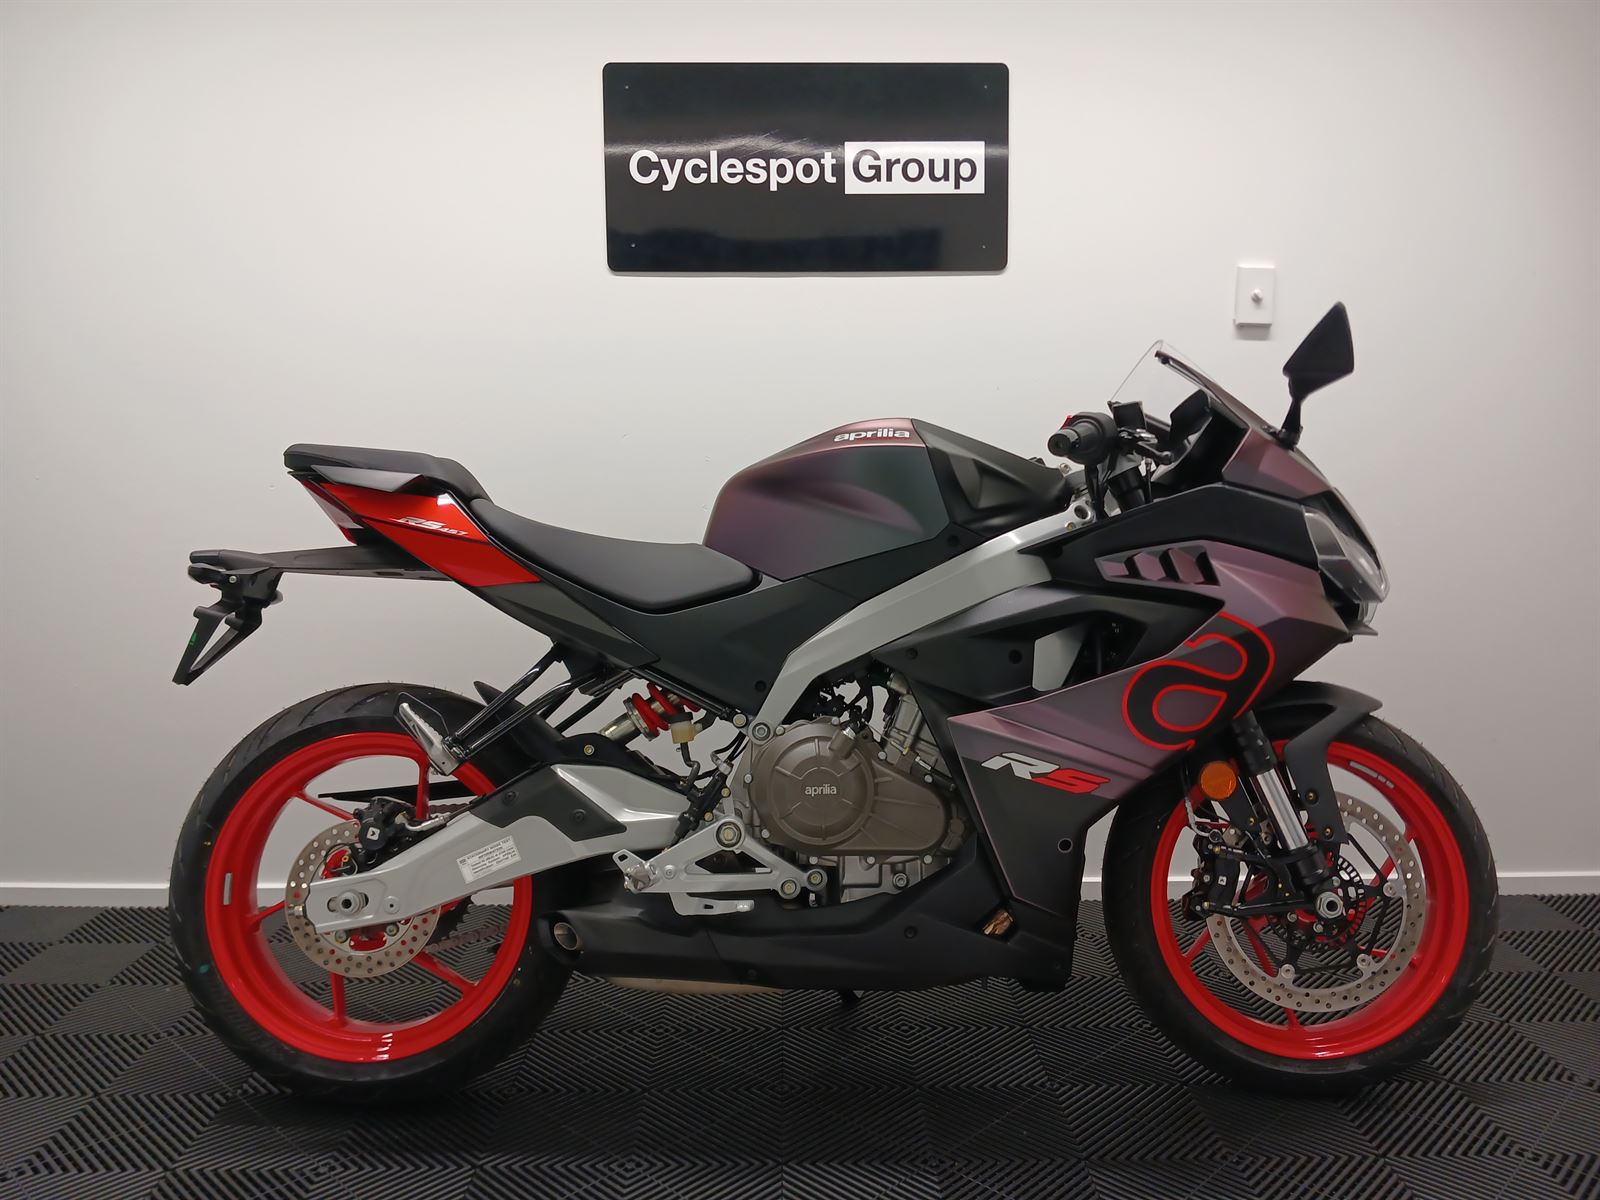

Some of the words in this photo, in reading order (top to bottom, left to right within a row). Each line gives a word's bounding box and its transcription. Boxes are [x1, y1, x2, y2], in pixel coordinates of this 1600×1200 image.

[628, 149, 837, 192] Cyclespot
[851, 148, 978, 190] Group
[833, 428, 910, 442] aprilia
[980, 751, 1112, 795] RS
[804, 783, 838, 797] aprilia
